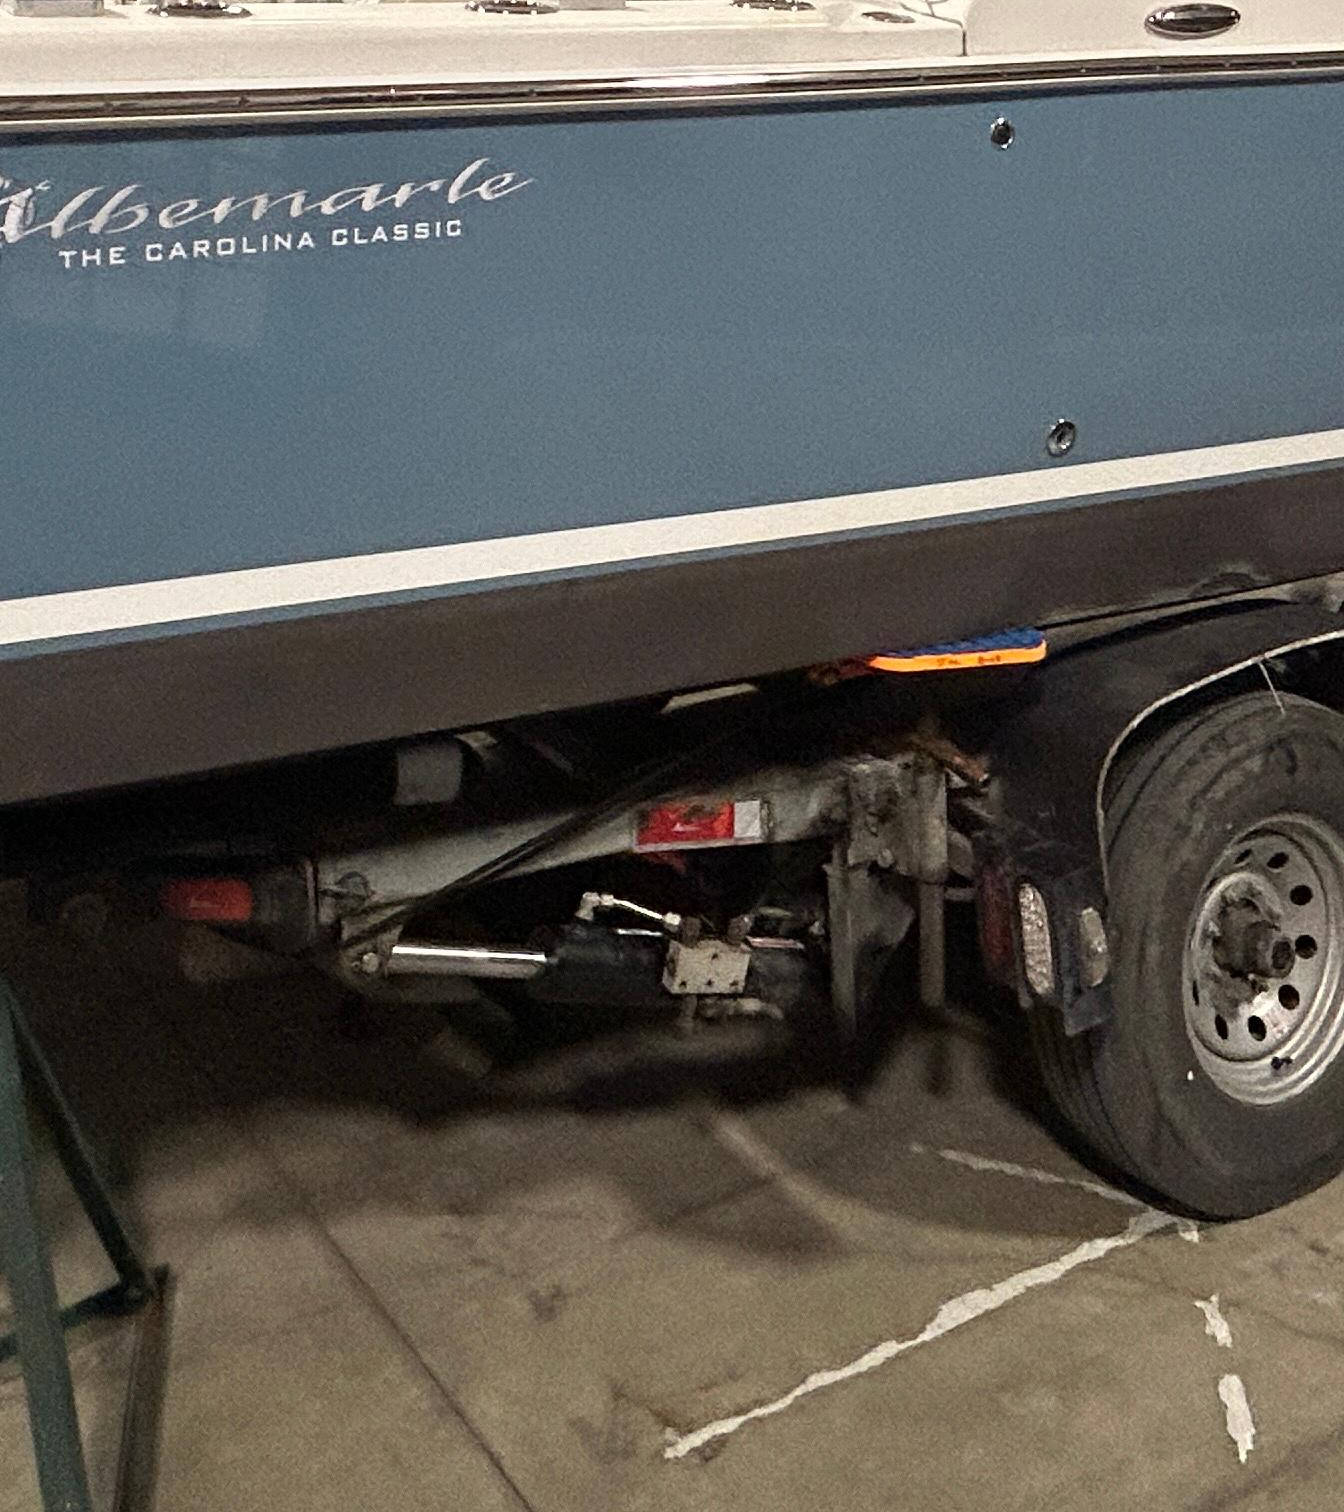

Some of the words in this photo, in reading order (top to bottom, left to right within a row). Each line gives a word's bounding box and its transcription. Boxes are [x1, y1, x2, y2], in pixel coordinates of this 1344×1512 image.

[58, 245, 127, 270] THE
[144, 231, 316, 263] CAROLINA
[330, 219, 464, 248] CLASSIC
